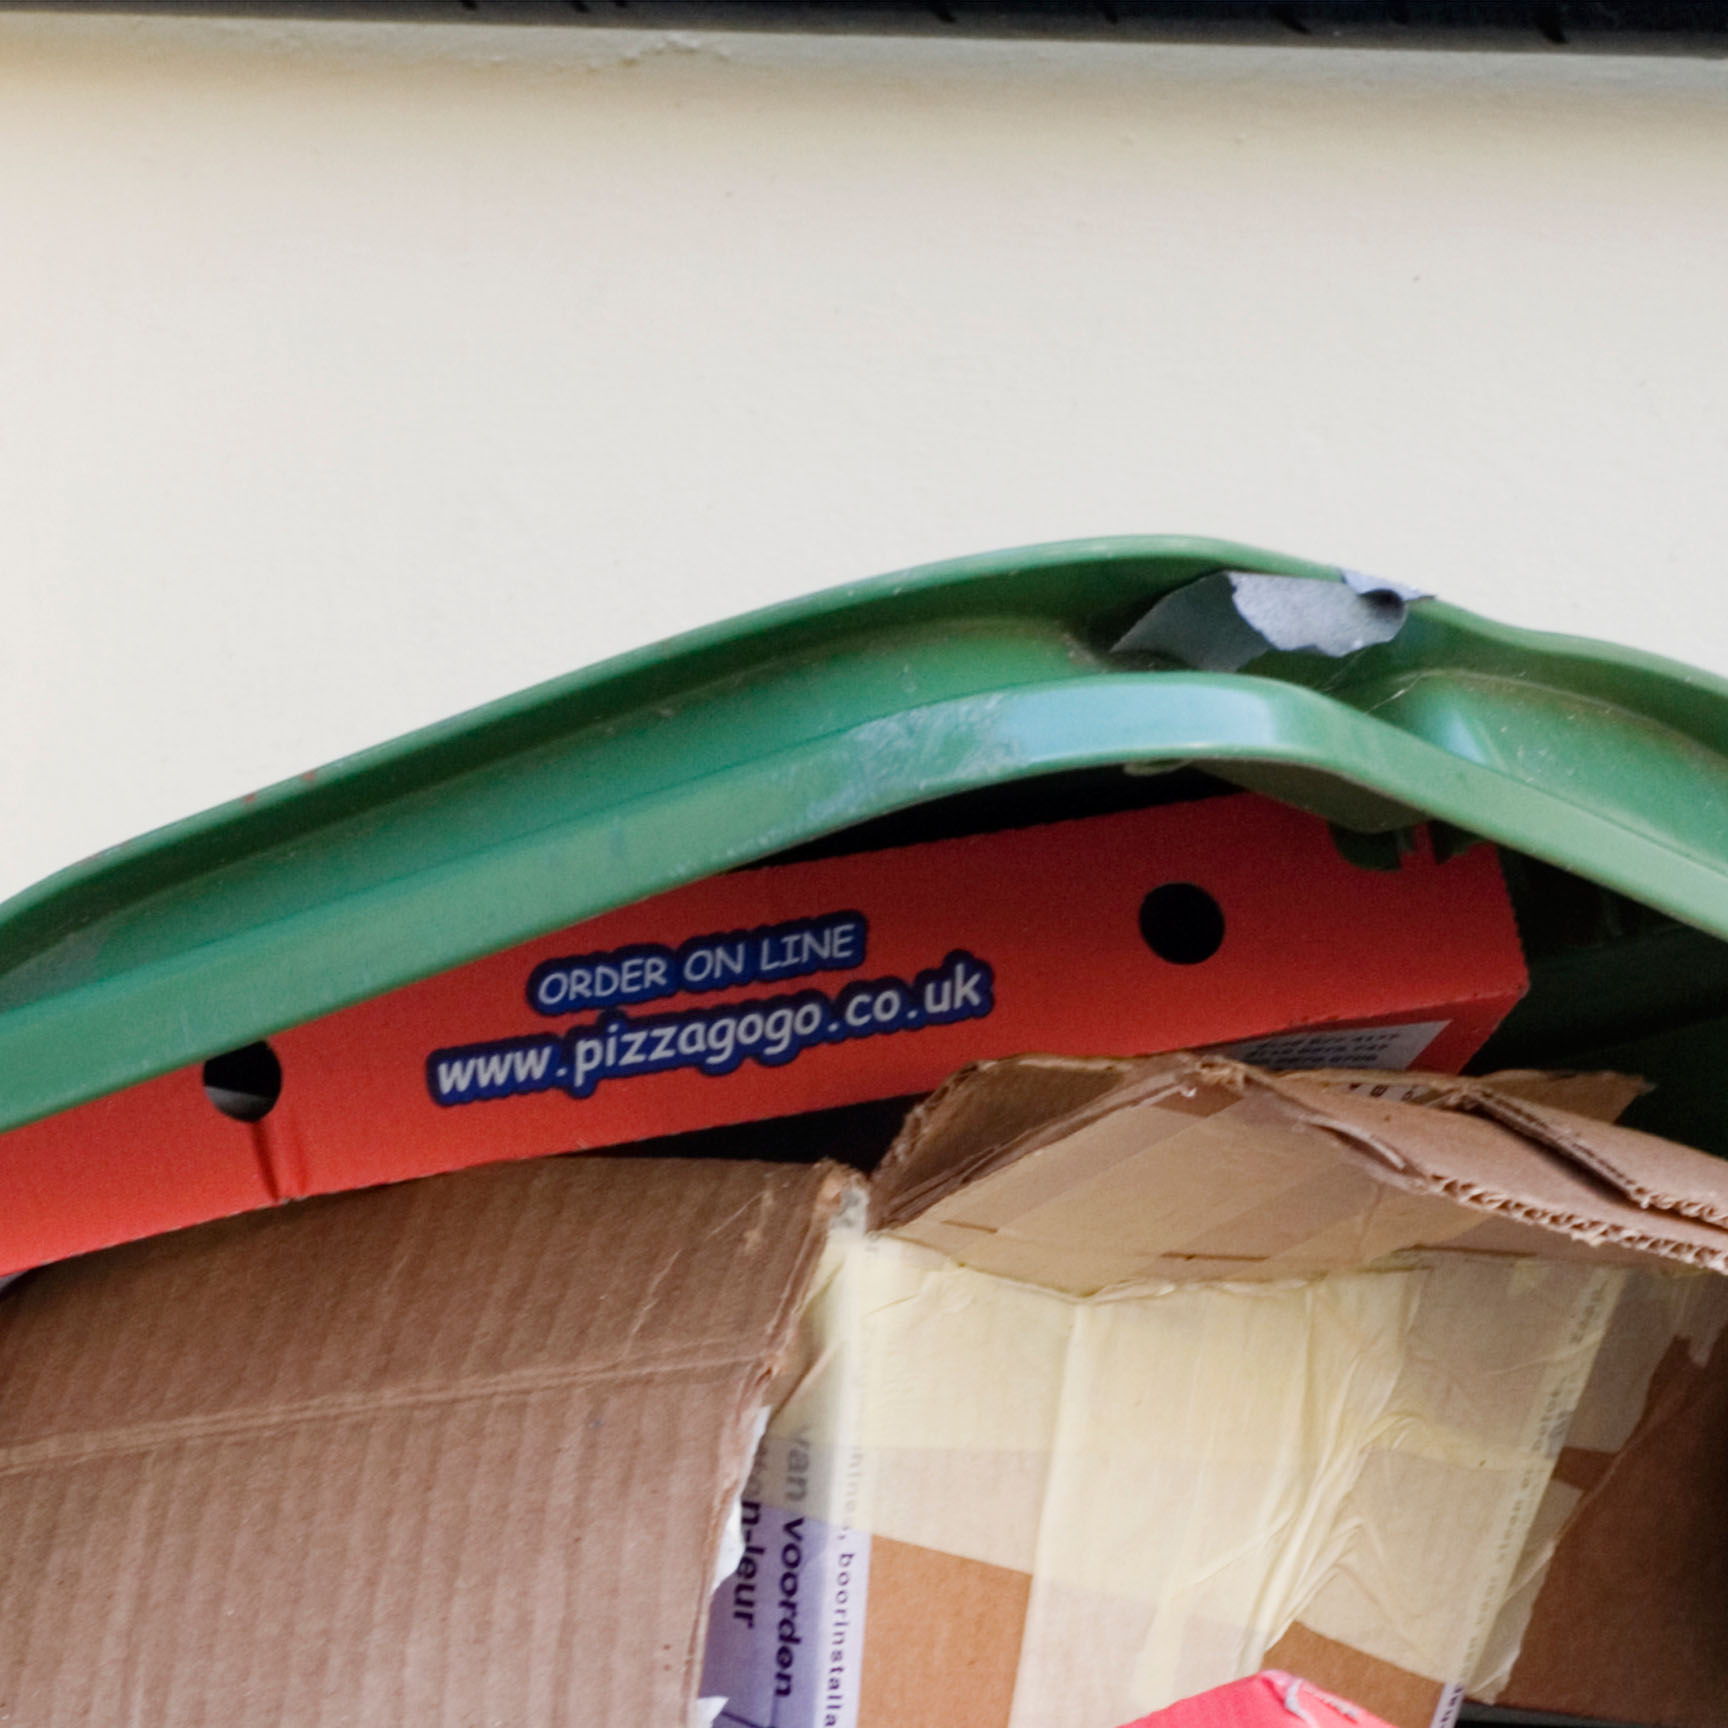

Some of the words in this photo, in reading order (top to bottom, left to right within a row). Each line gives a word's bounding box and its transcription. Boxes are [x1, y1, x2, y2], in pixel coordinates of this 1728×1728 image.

[436, 963, 983, 1095] www.pizzagogo.co.uk
[537, 957, 668, 1005] ORDER
[683, 943, 745, 983] ON
[759, 923, 856, 972] LINE
[774, 1517, 806, 1698] voorden
